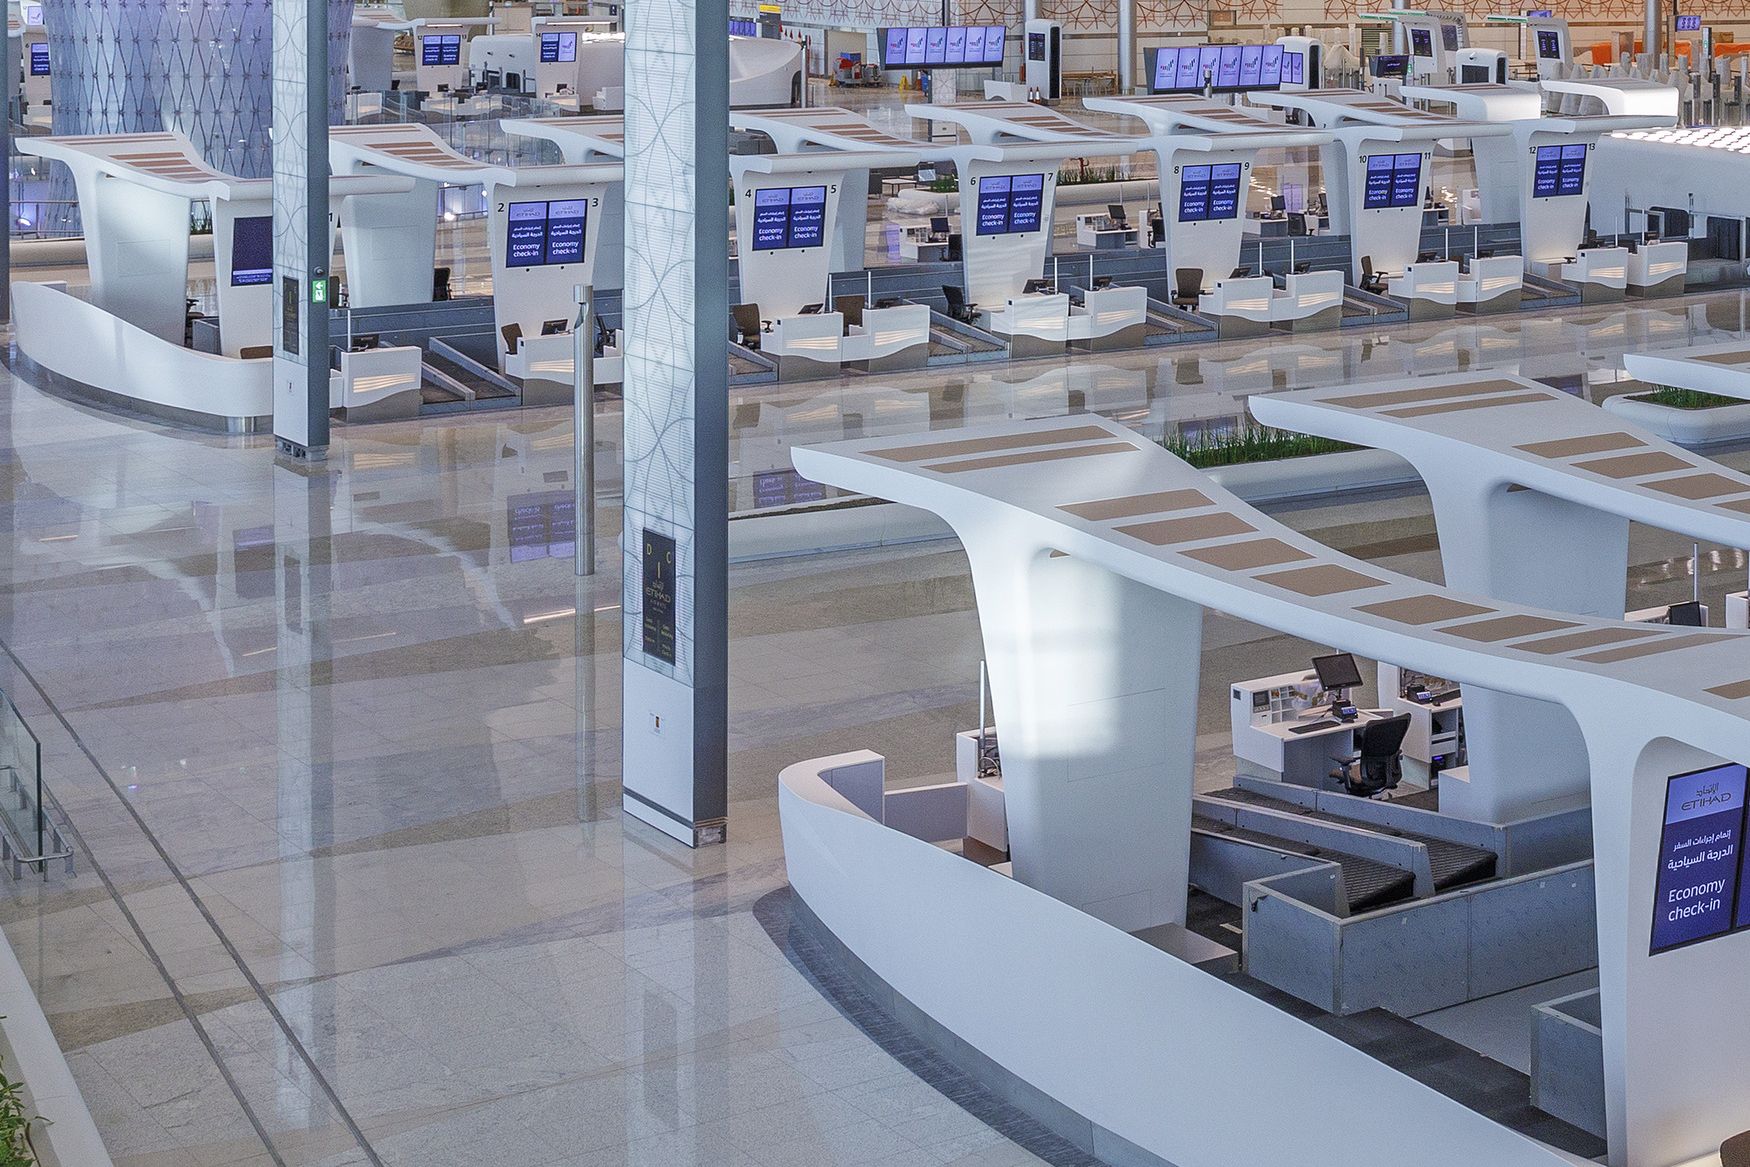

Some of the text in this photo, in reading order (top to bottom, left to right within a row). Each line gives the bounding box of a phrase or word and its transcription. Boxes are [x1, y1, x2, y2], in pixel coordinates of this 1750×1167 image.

[1359, 155, 1367, 163] 10
[1174, 166, 1179, 174] 8
[1245, 162, 1249, 170] 9
[970, 177, 976, 185] 6
[1048, 173, 1053, 181] 7
[745, 189, 751, 197] 4
[831, 185, 836, 193] 5
[592, 198, 598, 207] 3
[497, 203, 505, 212] 2
[647, 544, 671, 563] D C
[1681, 792, 1731, 811] ETIHAD
[1668, 844, 1734, 871] الدرجة السياحية
[1668, 879, 1726, 903] Economy
[1668, 898, 1721, 921] check-in
